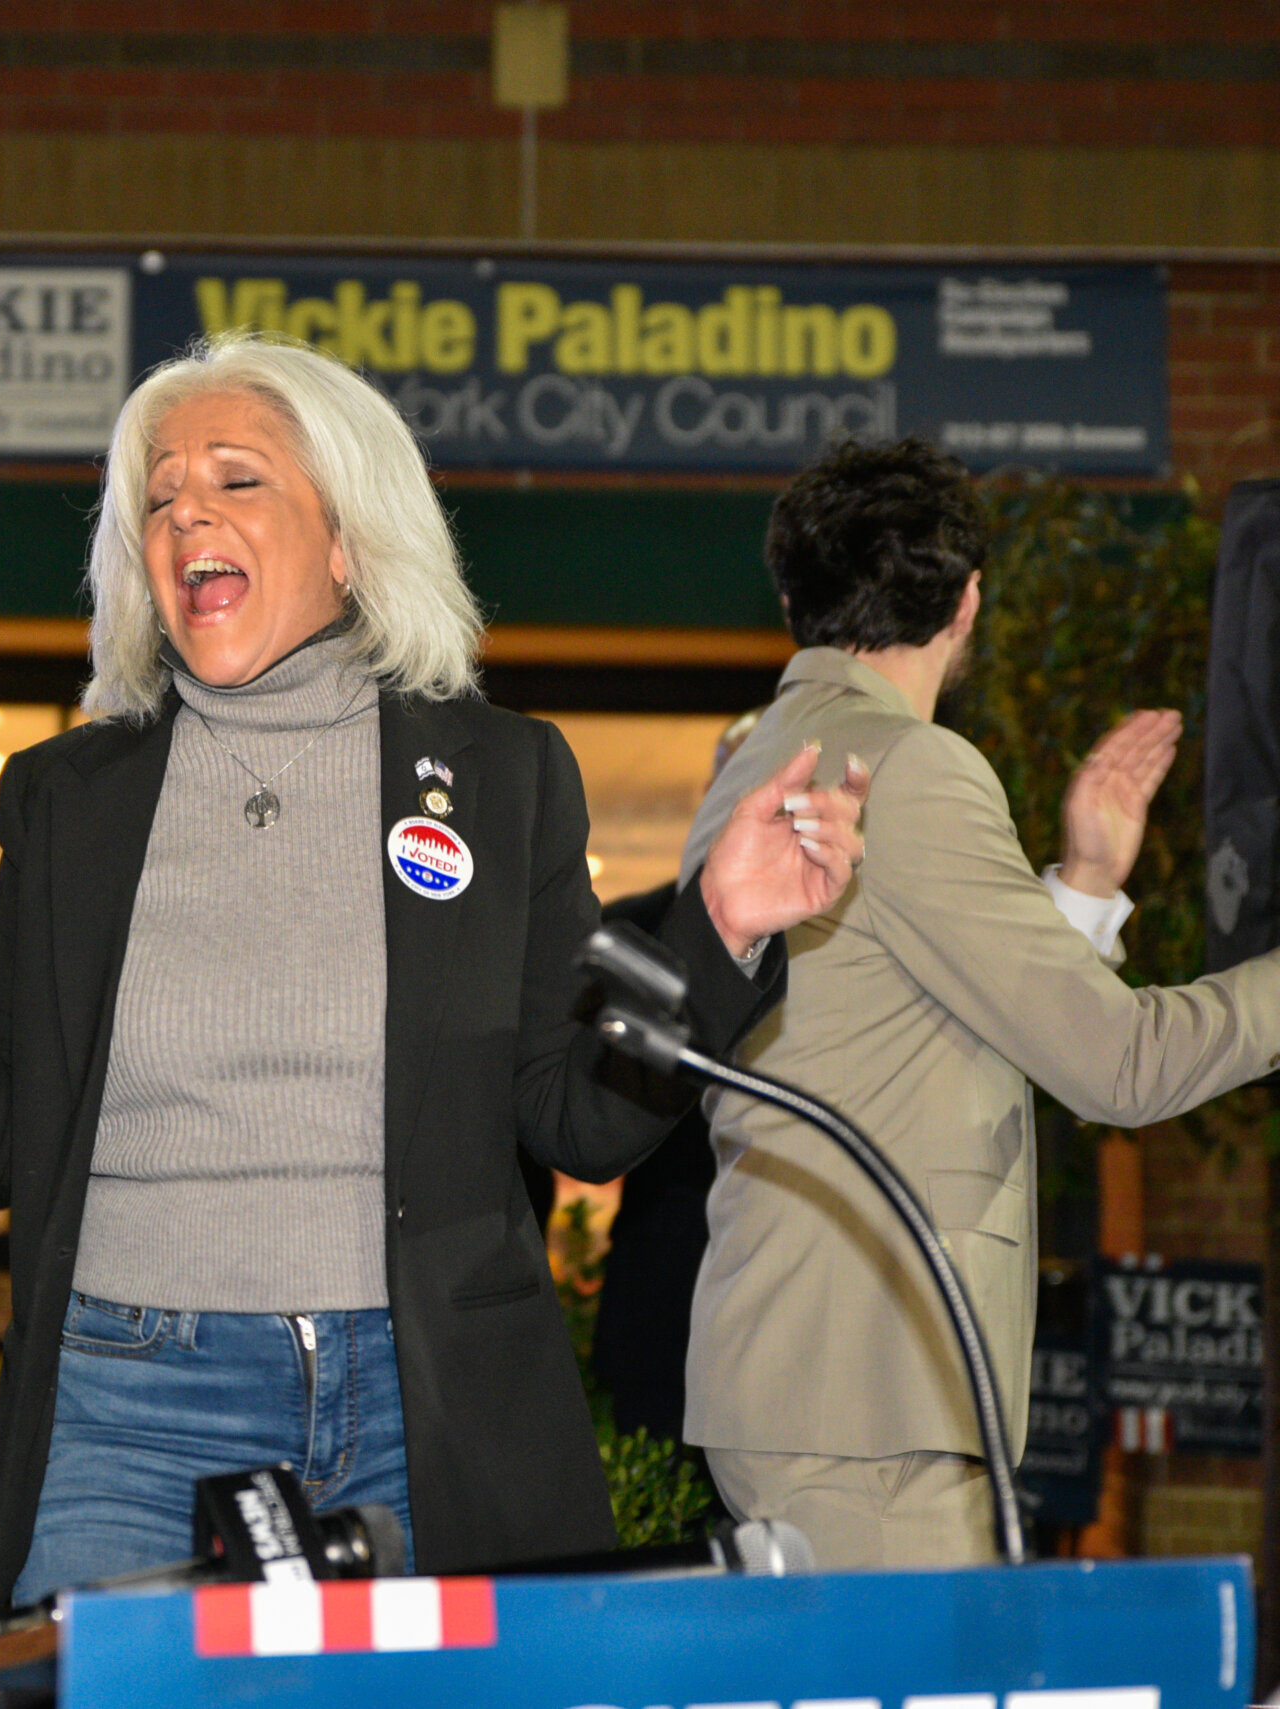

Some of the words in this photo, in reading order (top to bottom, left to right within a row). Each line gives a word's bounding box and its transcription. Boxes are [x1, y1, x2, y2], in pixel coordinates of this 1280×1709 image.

[195, 277, 477, 374] Vickie
[496, 281, 898, 378] Paladino
[520, 374, 643, 458] City
[656, 375, 898, 449] Council
[234, 1489, 284, 1561] NEWS
